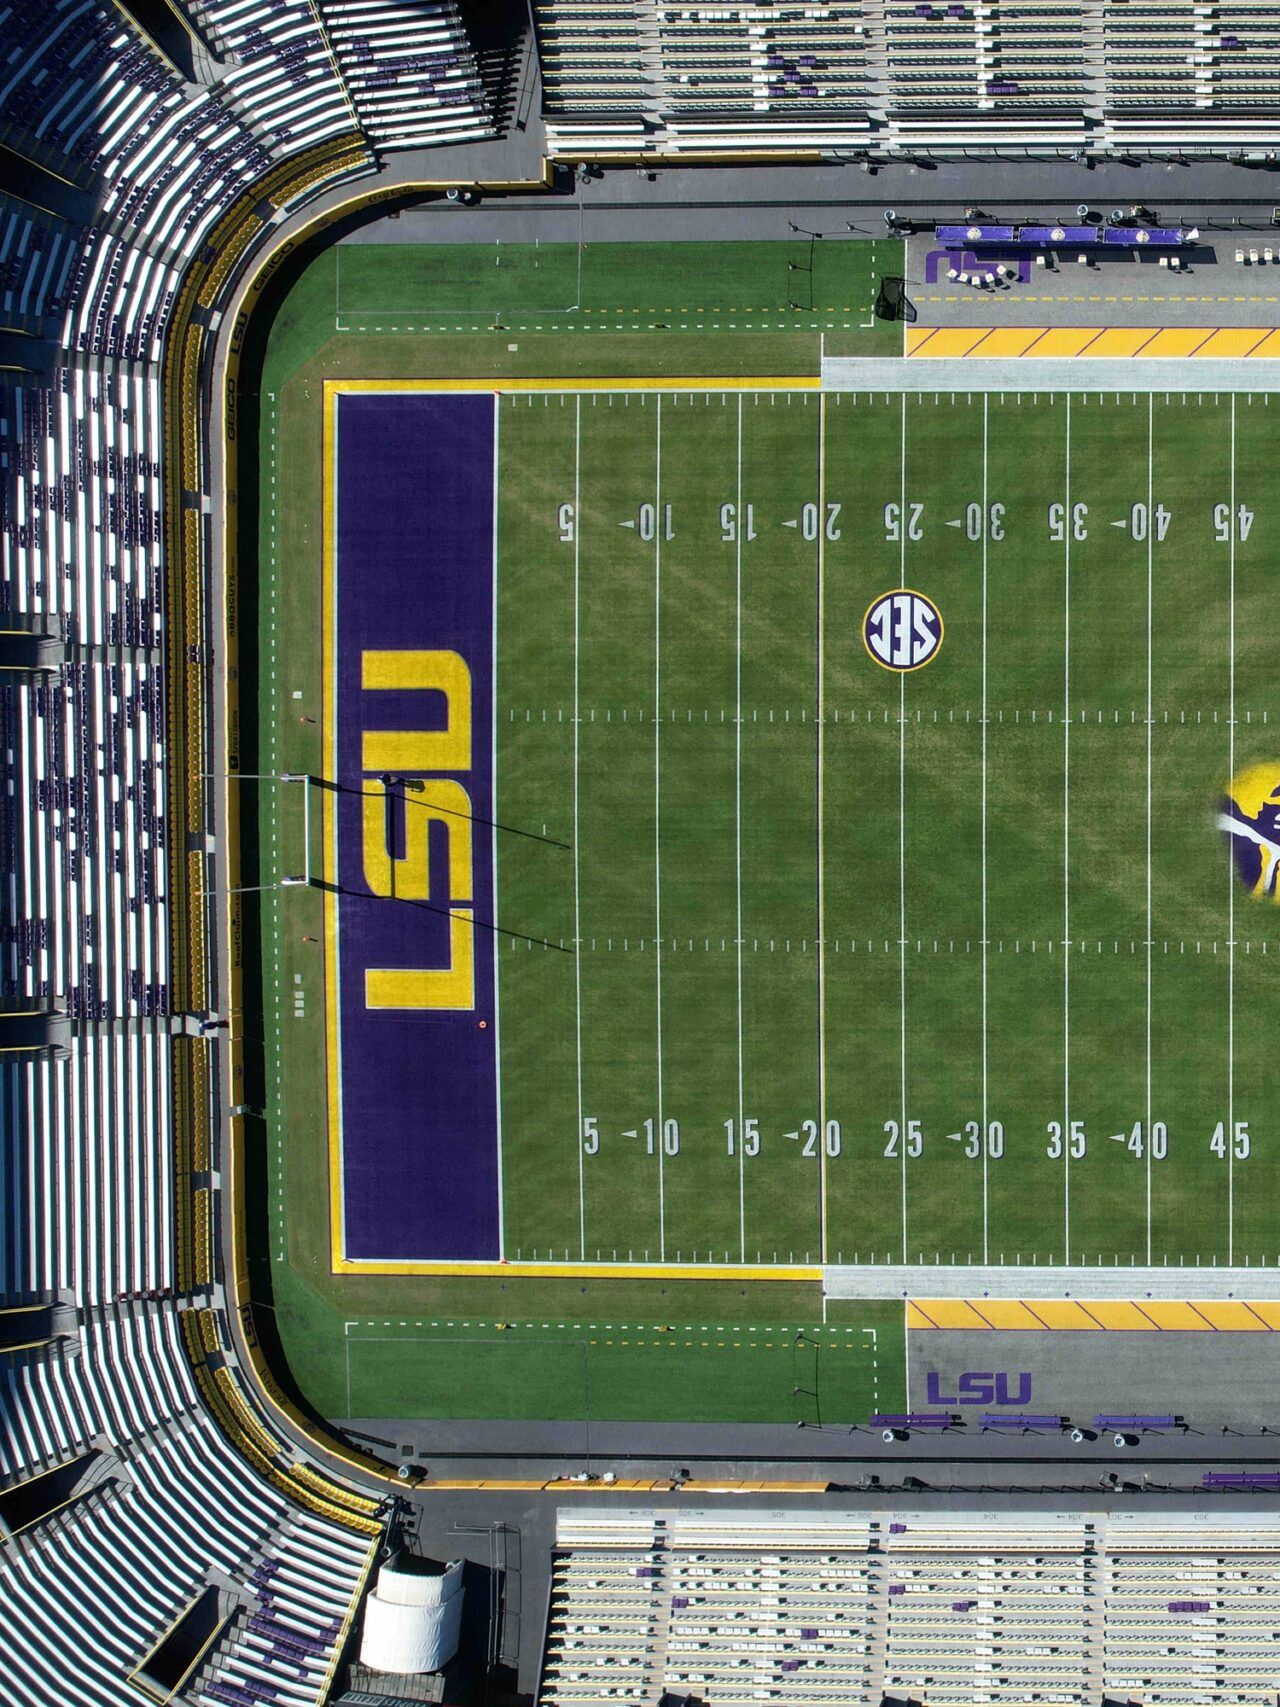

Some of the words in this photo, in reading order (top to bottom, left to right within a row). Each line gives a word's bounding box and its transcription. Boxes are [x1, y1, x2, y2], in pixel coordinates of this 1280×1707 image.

[252, 240, 295, 291] GEICO
[230, 311, 248, 355] LSU
[560, 504, 573, 541] 5
[641, 504, 674, 541] 10
[721, 504, 756, 541] 15
[803, 504, 841, 541] 20
[885, 504, 923, 541] 25
[967, 503, 1005, 540] 30
[1050, 503, 1088, 540] 35
[1133, 503, 1171, 540] 40
[1215, 504, 1253, 541] 45
[870, 596, 936, 665] SEC
[362, 650, 474, 1009] LSU
[584, 1118, 598, 1155] 5
[644, 1119, 678, 1156] 10
[724, 1119, 759, 1156] 15
[803, 1121, 840, 1158] 20
[884, 1121, 922, 1158] 25
[966, 1121, 1002, 1158] 30
[1047, 1122, 1085, 1159] 35
[1128, 1122, 1166, 1159] 40
[1210, 1122, 1249, 1159] 45
[241, 1306, 258, 1348] LSU
[928, 1372, 1032, 1405] LSU
